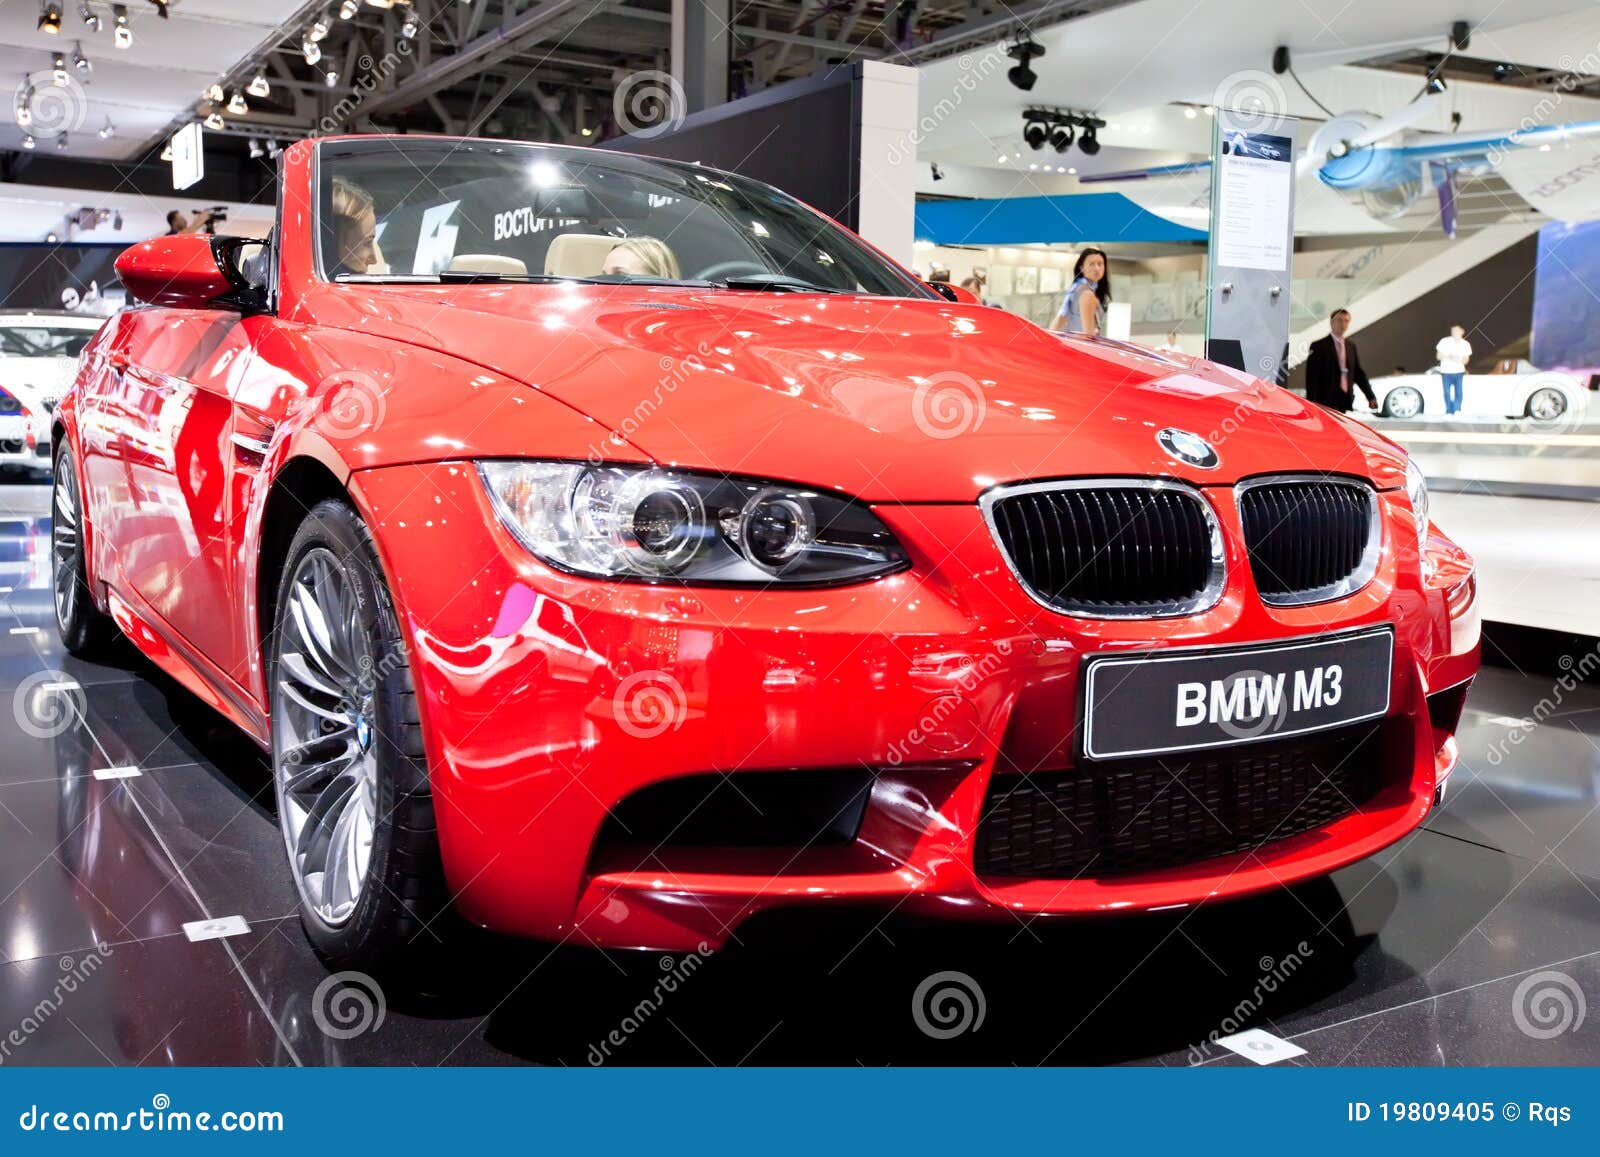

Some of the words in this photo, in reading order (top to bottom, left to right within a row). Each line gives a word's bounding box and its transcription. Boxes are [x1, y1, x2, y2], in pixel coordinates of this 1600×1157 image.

[494, 206, 554, 241] ВОСТО
[1176, 673, 1286, 726] BMW
[1293, 665, 1342, 711] M3
